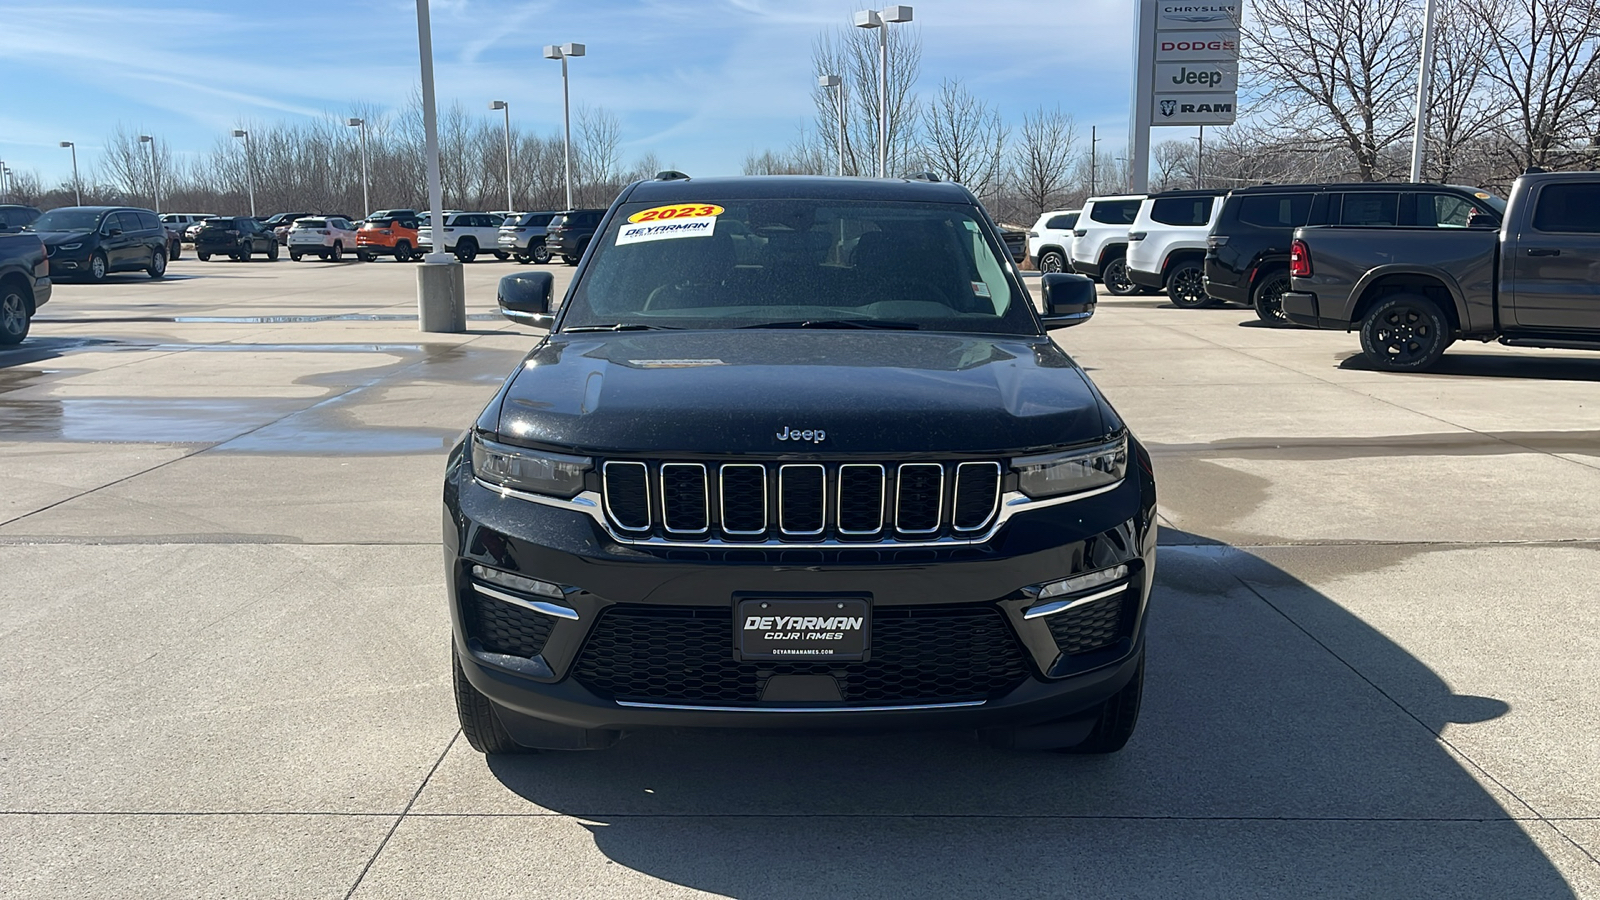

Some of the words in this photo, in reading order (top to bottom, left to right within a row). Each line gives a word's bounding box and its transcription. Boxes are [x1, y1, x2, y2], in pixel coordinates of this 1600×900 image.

[1161, 41, 1235, 51] DODGE
[1172, 67, 1222, 88] Jeep
[1180, 104, 1232, 113] RAM
[637, 206, 715, 223] 2023
[624, 222, 710, 237] DEYARMAN
[776, 426, 826, 444] Jeep
[743, 616, 864, 630] DEYARMAN
[806, 632, 844, 640] AMES
